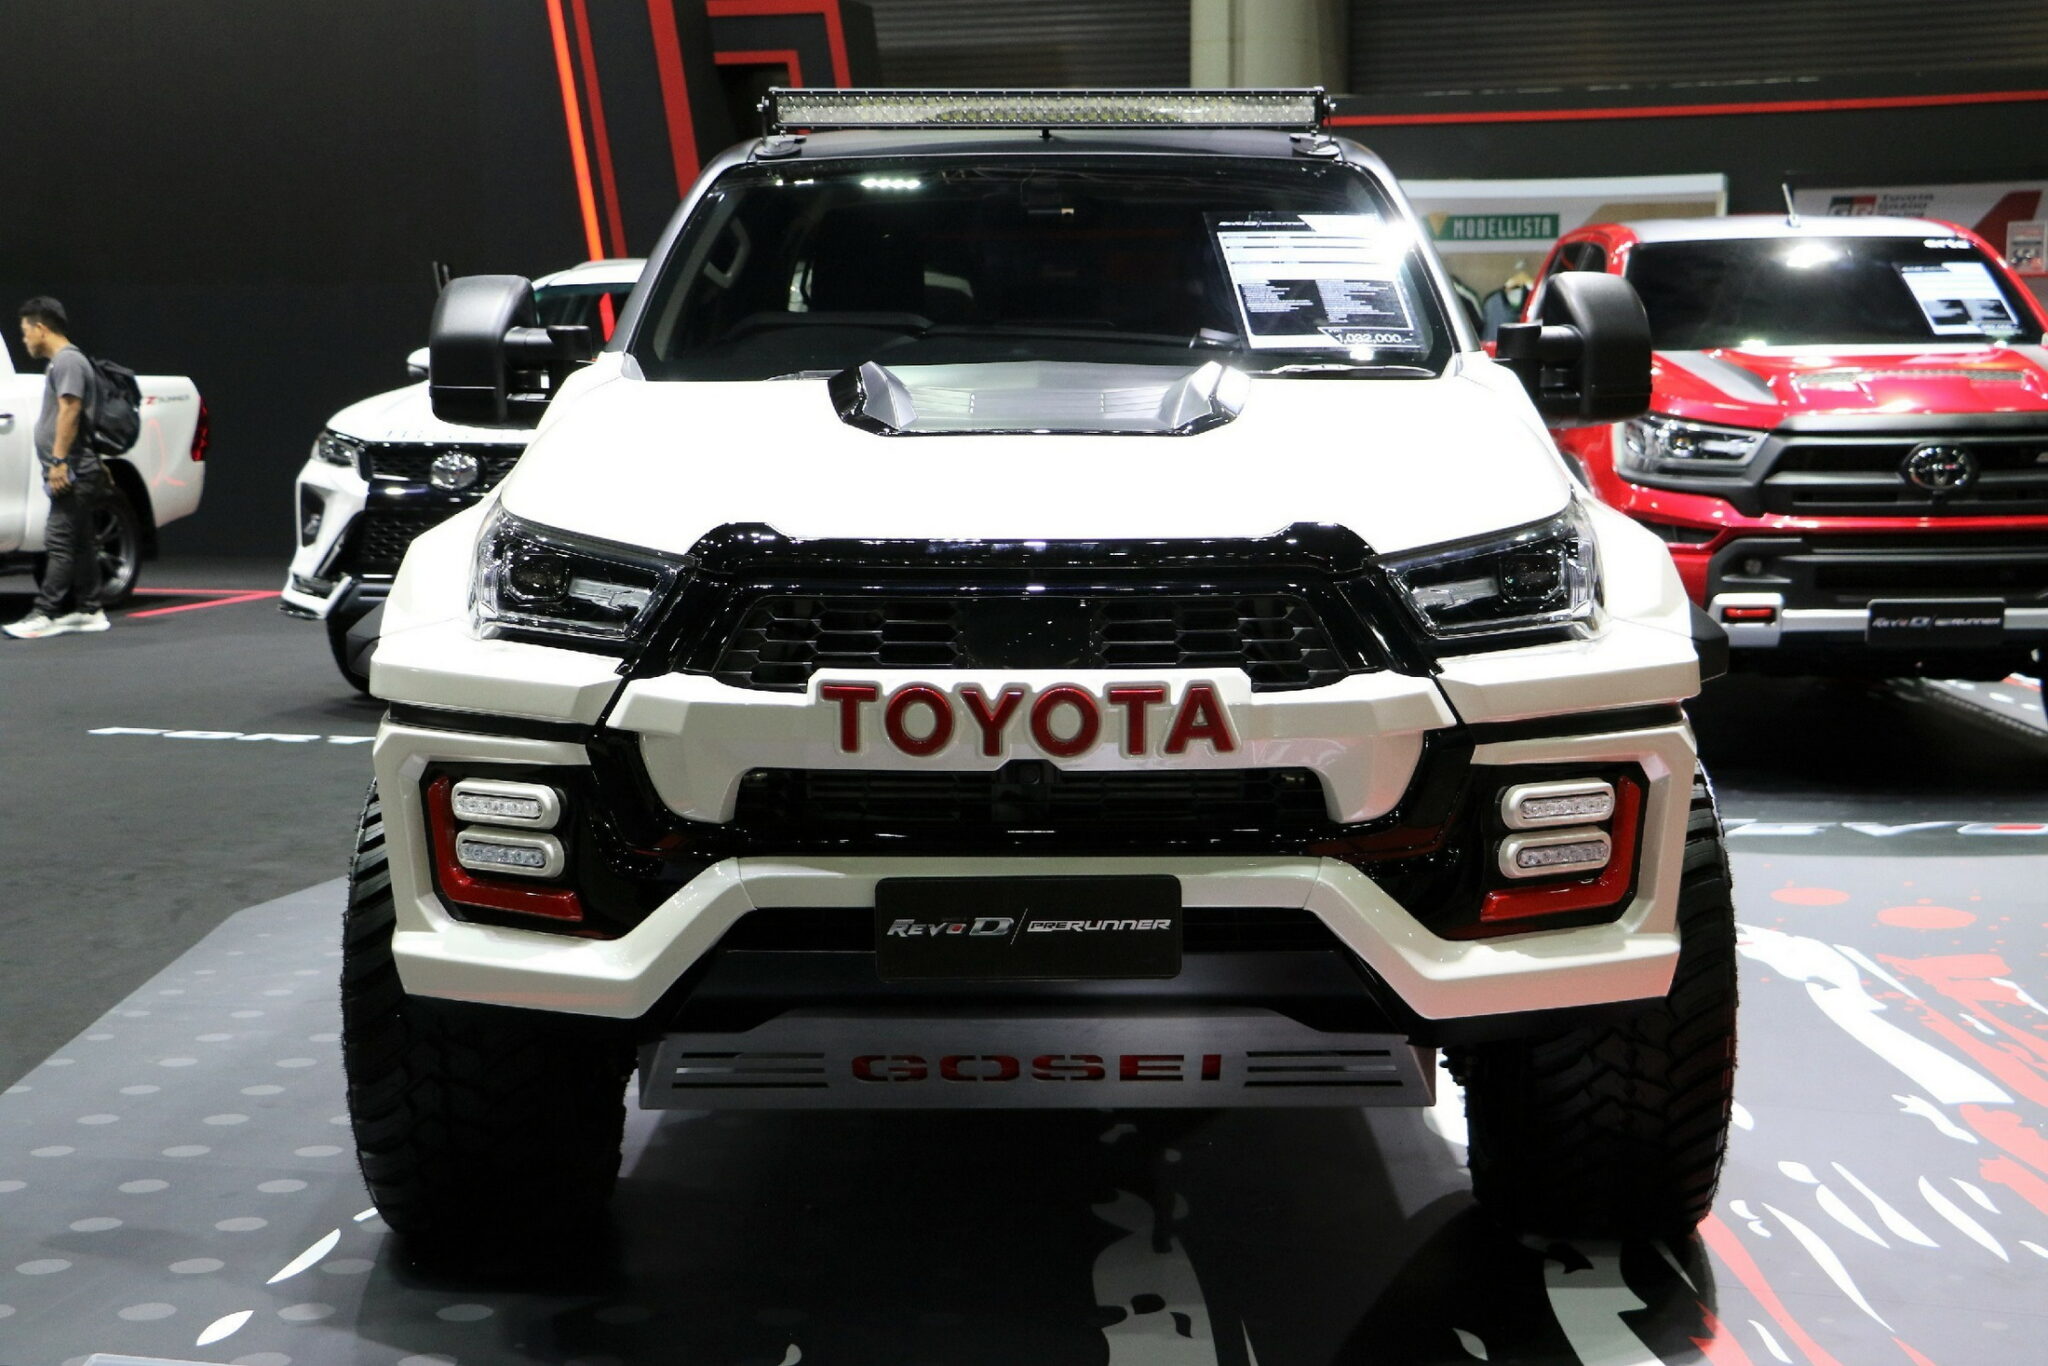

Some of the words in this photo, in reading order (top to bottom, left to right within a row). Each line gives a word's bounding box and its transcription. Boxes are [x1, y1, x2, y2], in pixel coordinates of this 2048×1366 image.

[1453, 217, 1551, 239] MODELLISTA
[821, 682, 1236, 758] TOYOTA
[1721, 818, 2048, 838] EVO
[968, 916, 1015, 936] D
[1026, 918, 1172, 933] PRERUNNER
[851, 1054, 1222, 1083] GOSEI
